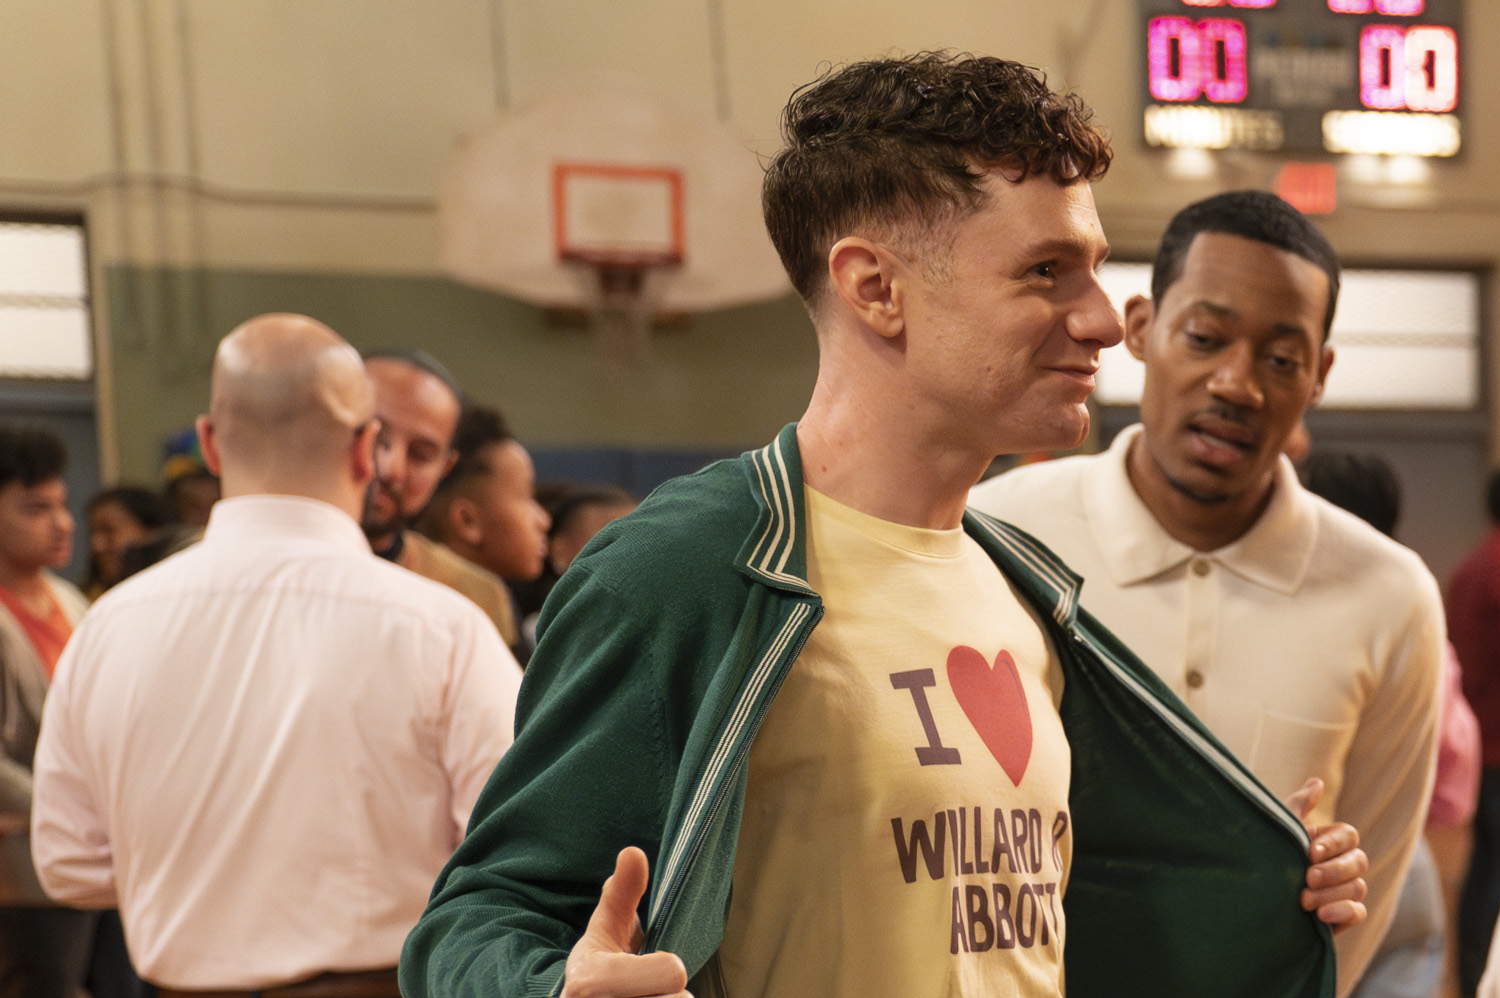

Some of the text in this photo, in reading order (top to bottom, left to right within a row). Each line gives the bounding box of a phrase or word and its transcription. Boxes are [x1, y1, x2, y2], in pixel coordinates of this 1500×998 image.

[1147, 15, 1248, 103] 00
[889, 668, 962, 766] I
[890, 806, 1042, 884] WILLARD
[950, 882, 1061, 954] ABBOTT
